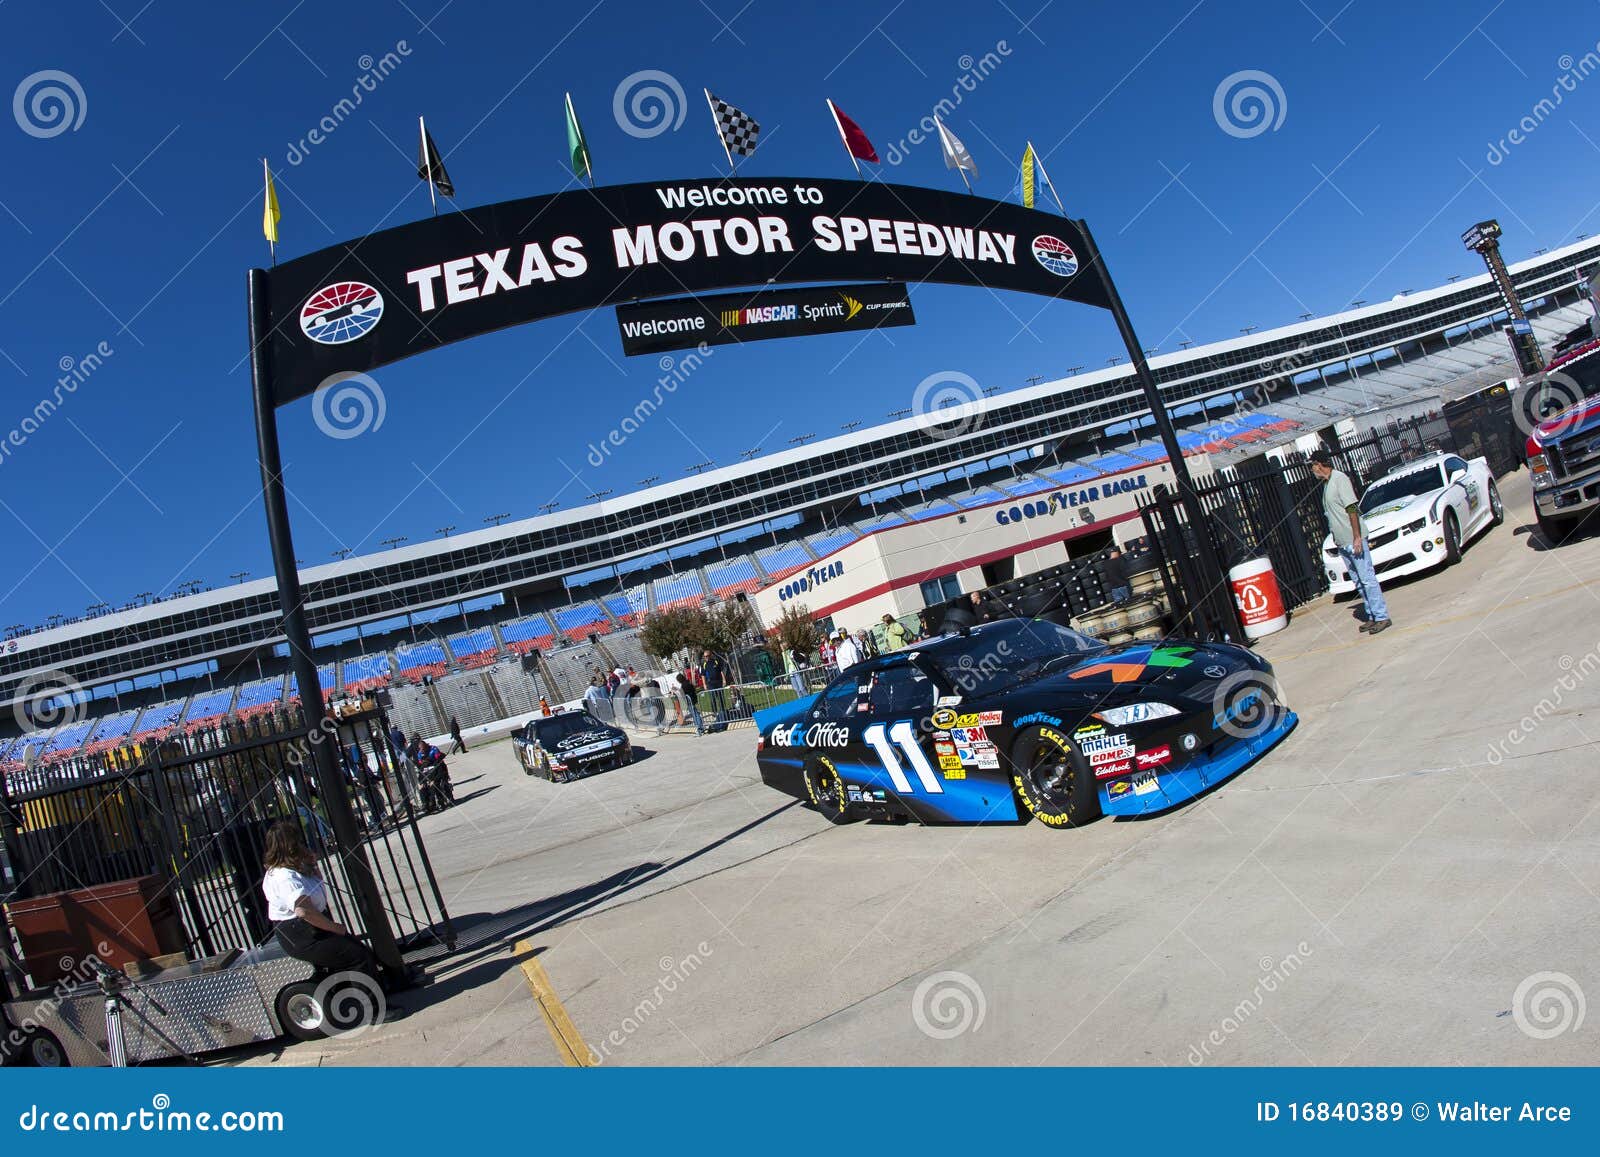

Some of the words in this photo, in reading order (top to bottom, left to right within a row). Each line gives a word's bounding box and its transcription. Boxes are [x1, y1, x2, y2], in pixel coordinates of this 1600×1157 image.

[656, 185, 787, 209] Welcome
[795, 184, 824, 205] to
[406, 235, 588, 313] TEXAS
[612, 216, 793, 268] MOTOR
[811, 215, 1015, 265] SPEEDWAY
[622, 315, 705, 338] Welcome
[746, 304, 796, 325] NASCAR
[803, 302, 844, 321] Sprint
[996, 487, 1099, 525] GOODYEAR
[1102, 475, 1148, 498] EAGLE
[778, 560, 844, 602] GOODYEAR
[980, 712, 1001, 721] Holley
[1013, 711, 1062, 728] GOODYEAR
[1124, 702, 1149, 722] 11
[771, 722, 808, 747] FedEx
[806, 722, 849, 748] Office
[966, 727, 987, 742] 3M
[1039, 727, 1072, 754] EAGLE
[1083, 734, 1127, 754] MAHLE
[578, 751, 615, 763] FUSION
[863, 719, 944, 795] 11
[1092, 749, 1125, 763] COMP
[944, 769, 966, 779] JEGS
[1095, 761, 1131, 776] Edelbrock
[1133, 772, 1156, 787] WIX
